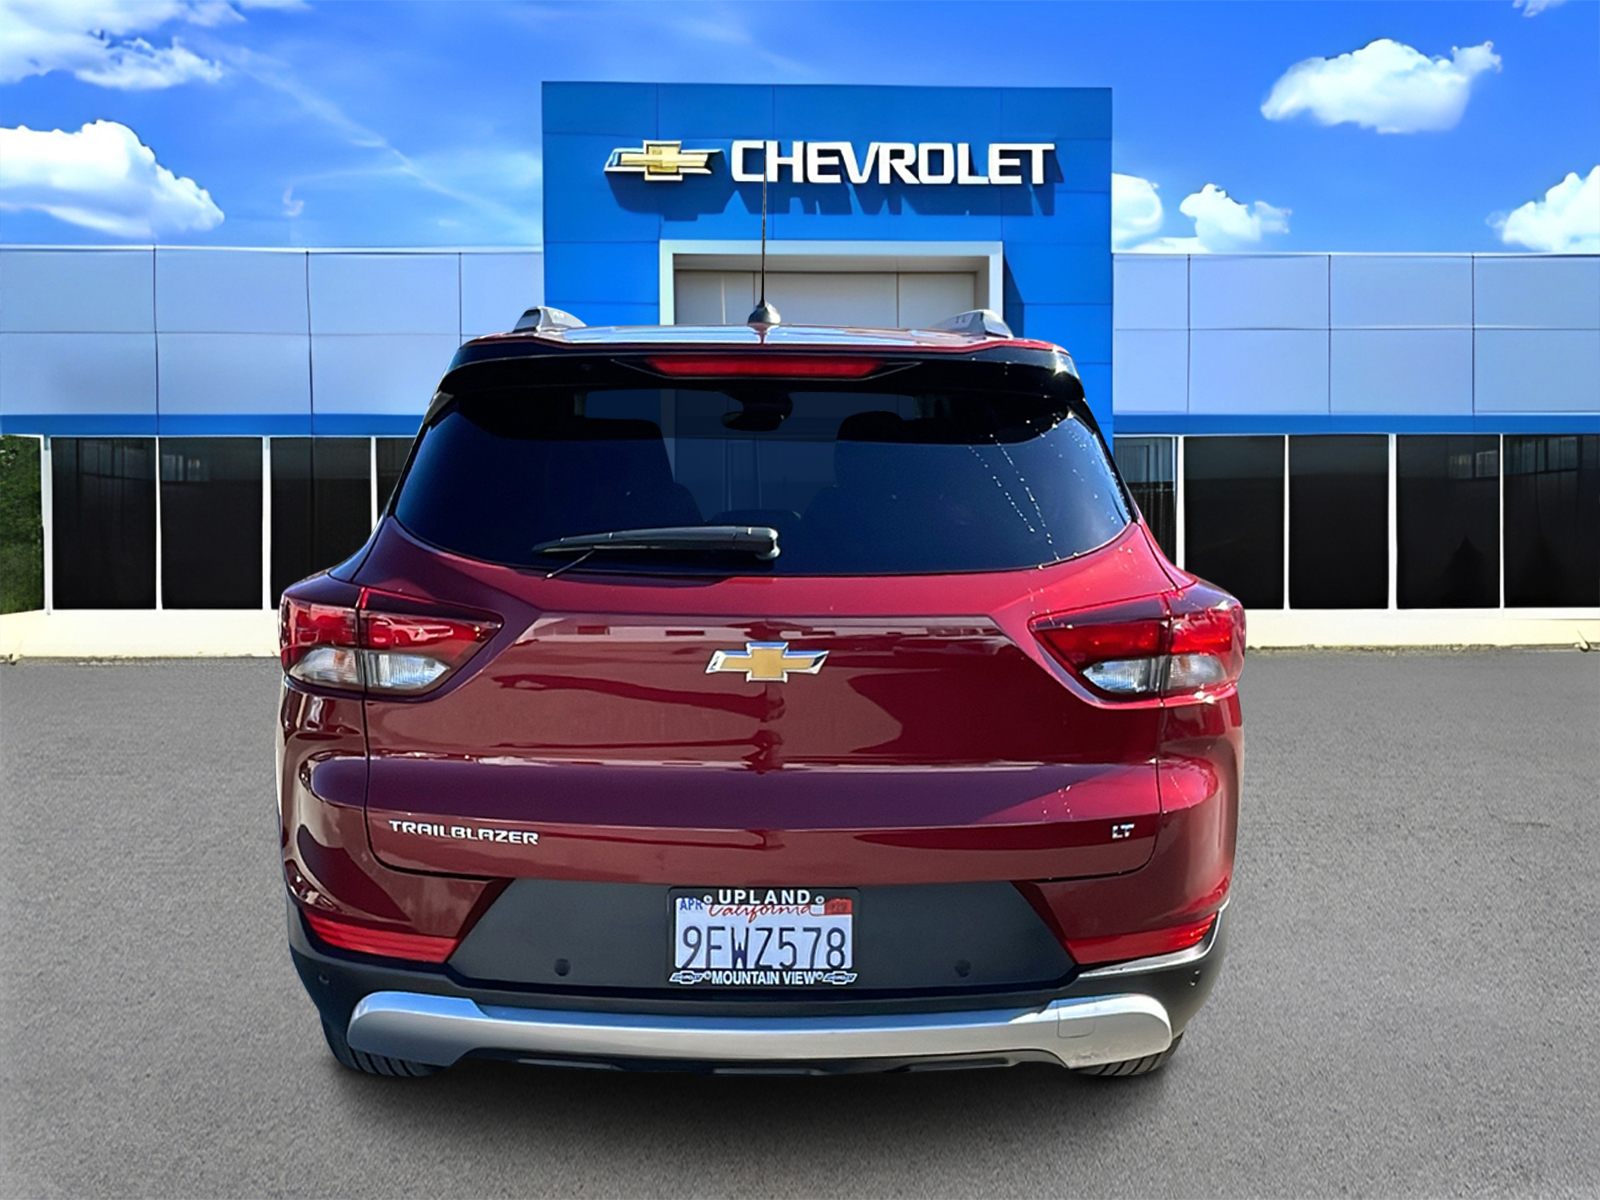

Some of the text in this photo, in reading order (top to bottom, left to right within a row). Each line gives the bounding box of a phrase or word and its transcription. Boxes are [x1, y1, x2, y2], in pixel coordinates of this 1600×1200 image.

[731, 140, 1055, 185] CHEVROLET
[388, 819, 539, 846] TRAILBLAZER
[1112, 823, 1135, 839] LT
[679, 898, 703, 911] APR
[718, 889, 811, 904] UPLAND
[682, 926, 846, 969] 9FWZ578
[711, 971, 780, 985] MOUNTAIN
[782, 971, 816, 985] VIEW
